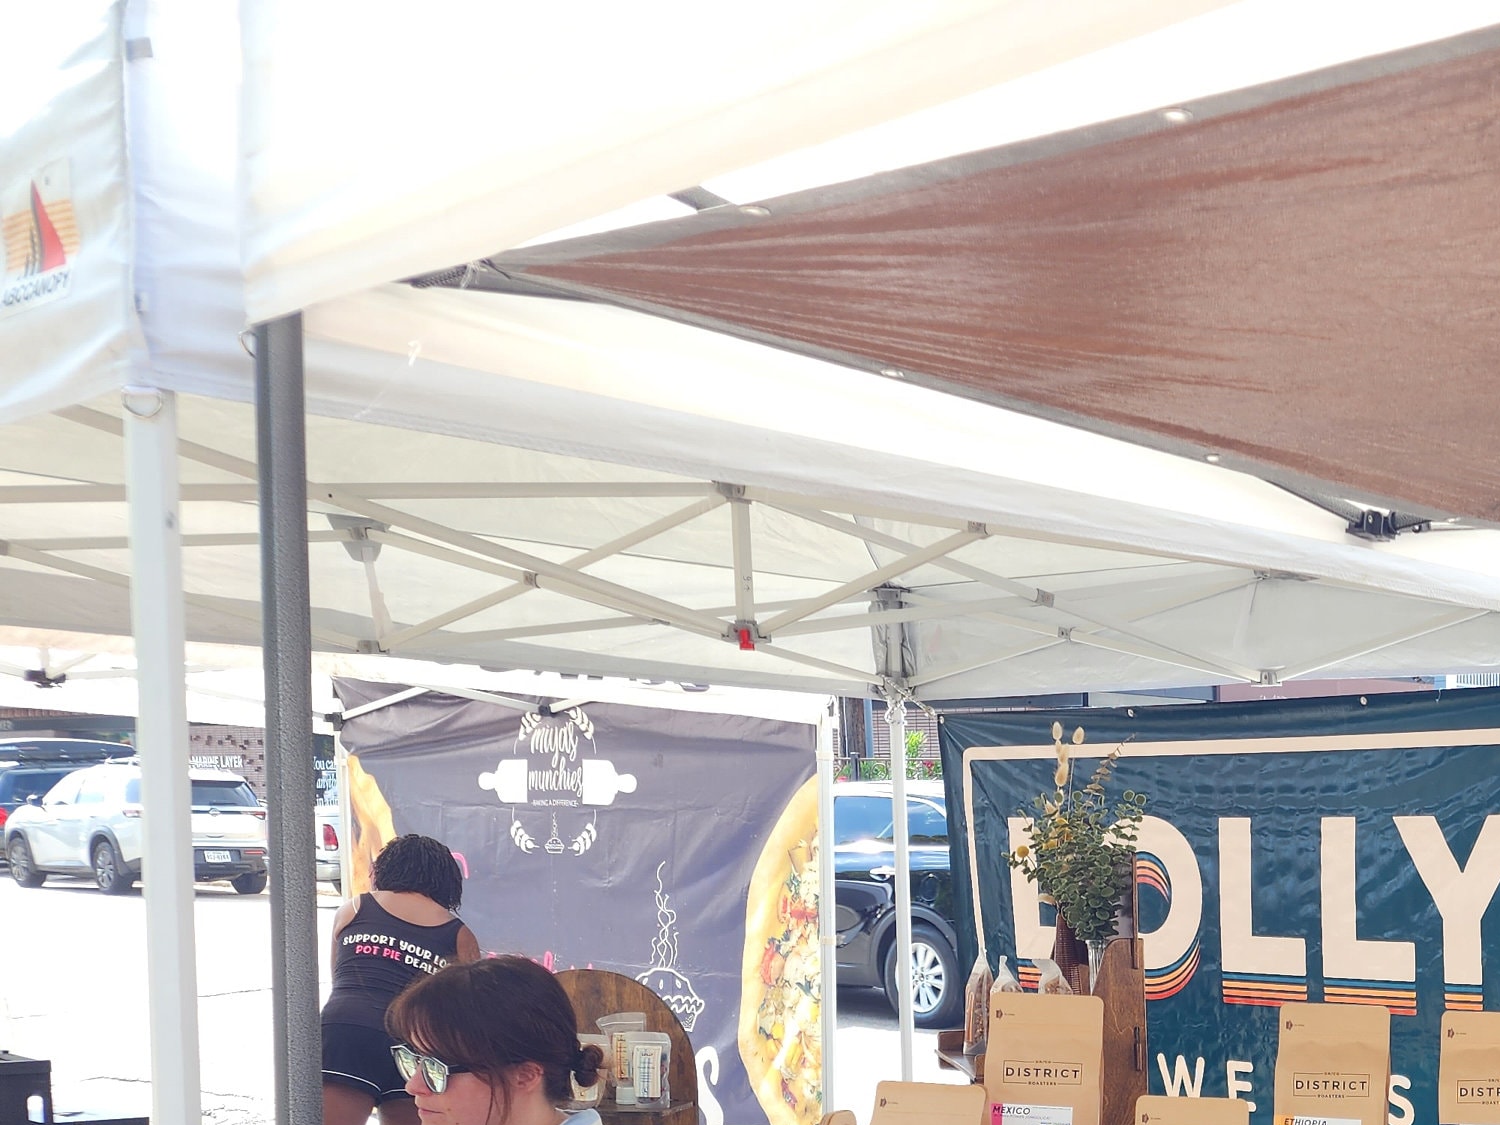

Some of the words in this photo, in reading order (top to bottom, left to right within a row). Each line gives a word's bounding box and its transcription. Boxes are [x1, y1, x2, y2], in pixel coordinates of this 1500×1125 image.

[220, 754, 243, 768] LAYER
[528, 757, 583, 797] munchies
[343, 934, 397, 946] SUPPORT
[399, 940, 432, 960] YOUR
[355, 944, 383, 955] POT
[383, 948, 402, 961] PIE
[1005, 1067, 1080, 1079] DISTRICT
[1295, 1080, 1367, 1091] DISTRICT
[992, 1105, 1031, 1115] MEXICO
